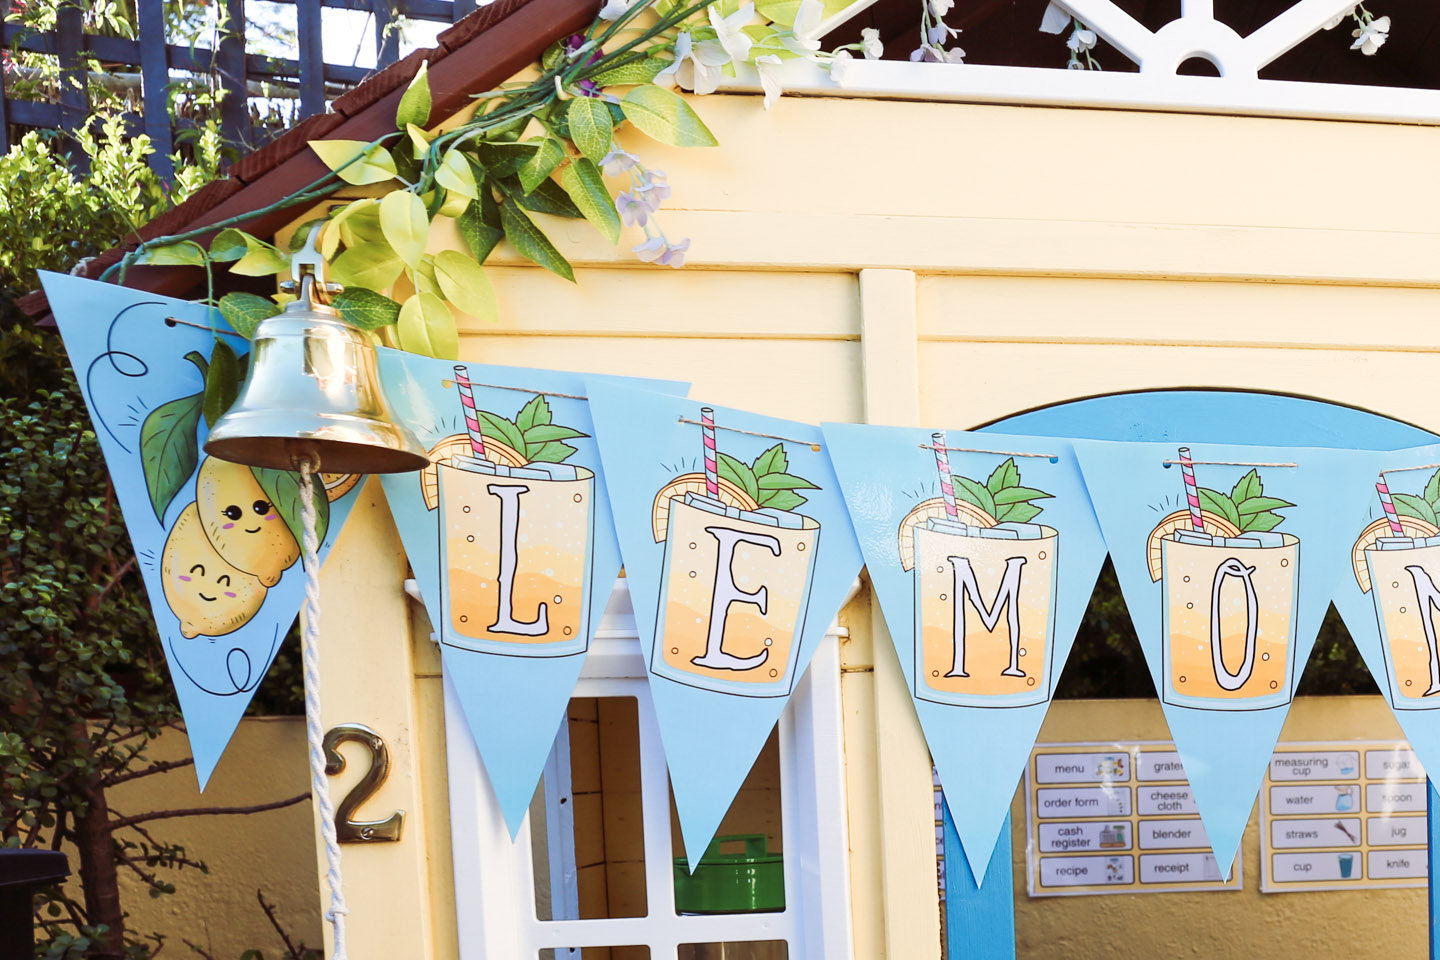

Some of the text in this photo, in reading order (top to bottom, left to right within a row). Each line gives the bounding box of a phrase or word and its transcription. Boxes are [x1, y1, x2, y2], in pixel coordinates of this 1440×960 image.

[1054, 764, 1084, 774] menu
[1274, 758, 1329, 769] measuring
[1292, 767, 1311, 777] cup
[322, 723, 405, 843] 2
[1150, 790, 1189, 801] cheese
[1285, 796, 1314, 805] water
[1043, 797, 1099, 809] order form
[1157, 801, 1183, 812] cloth
[1057, 825, 1083, 836] cash
[1152, 829, 1192, 840] blender
[1285, 829, 1319, 840] straws
[1391, 827, 1407, 838] jug
[1051, 838, 1091, 851] register
[1154, 863, 1190, 875] receipt
[1293, 862, 1312, 873] cup
[1386, 858, 1411, 869] knife
[1055, 865, 1089, 877] recipe
